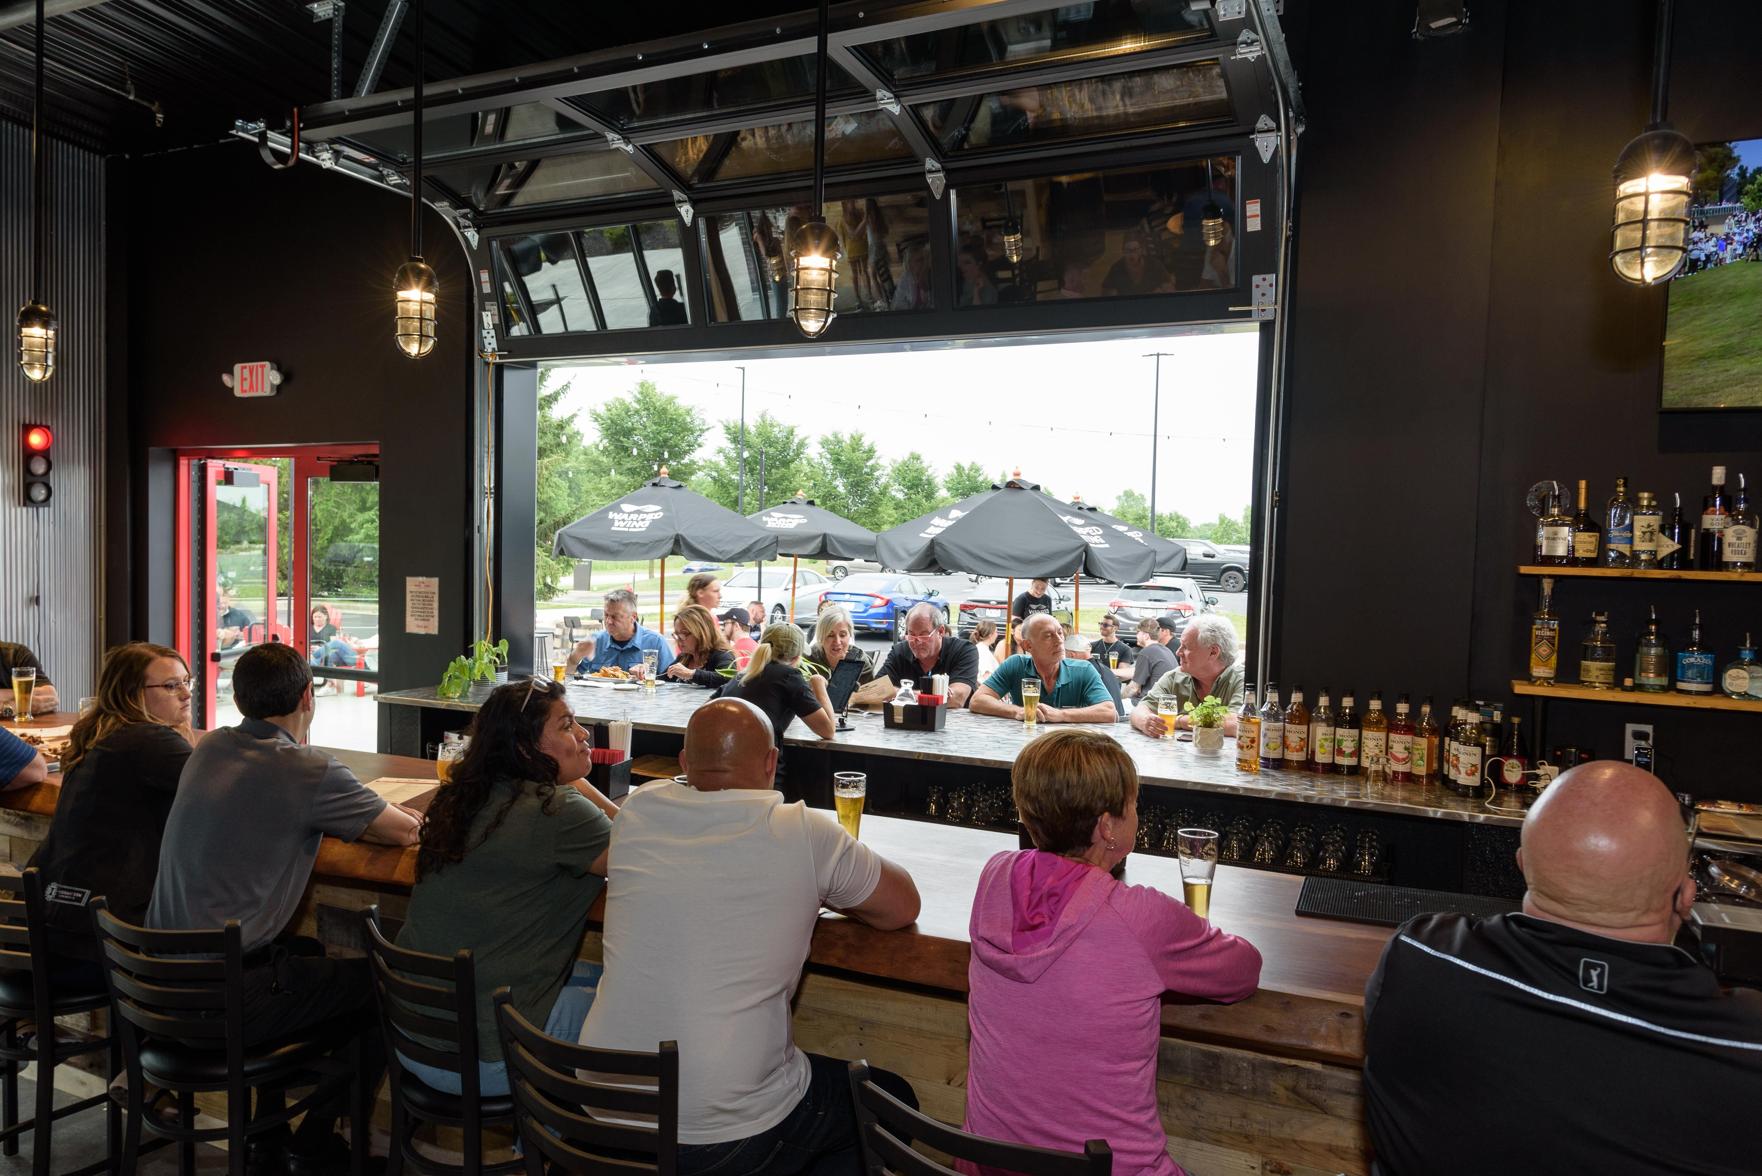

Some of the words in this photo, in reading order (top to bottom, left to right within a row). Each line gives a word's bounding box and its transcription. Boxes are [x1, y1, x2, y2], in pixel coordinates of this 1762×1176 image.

[240, 364, 267, 393] EXIT
[608, 511, 664, 521] WARPED
[613, 519, 652, 528] WING
